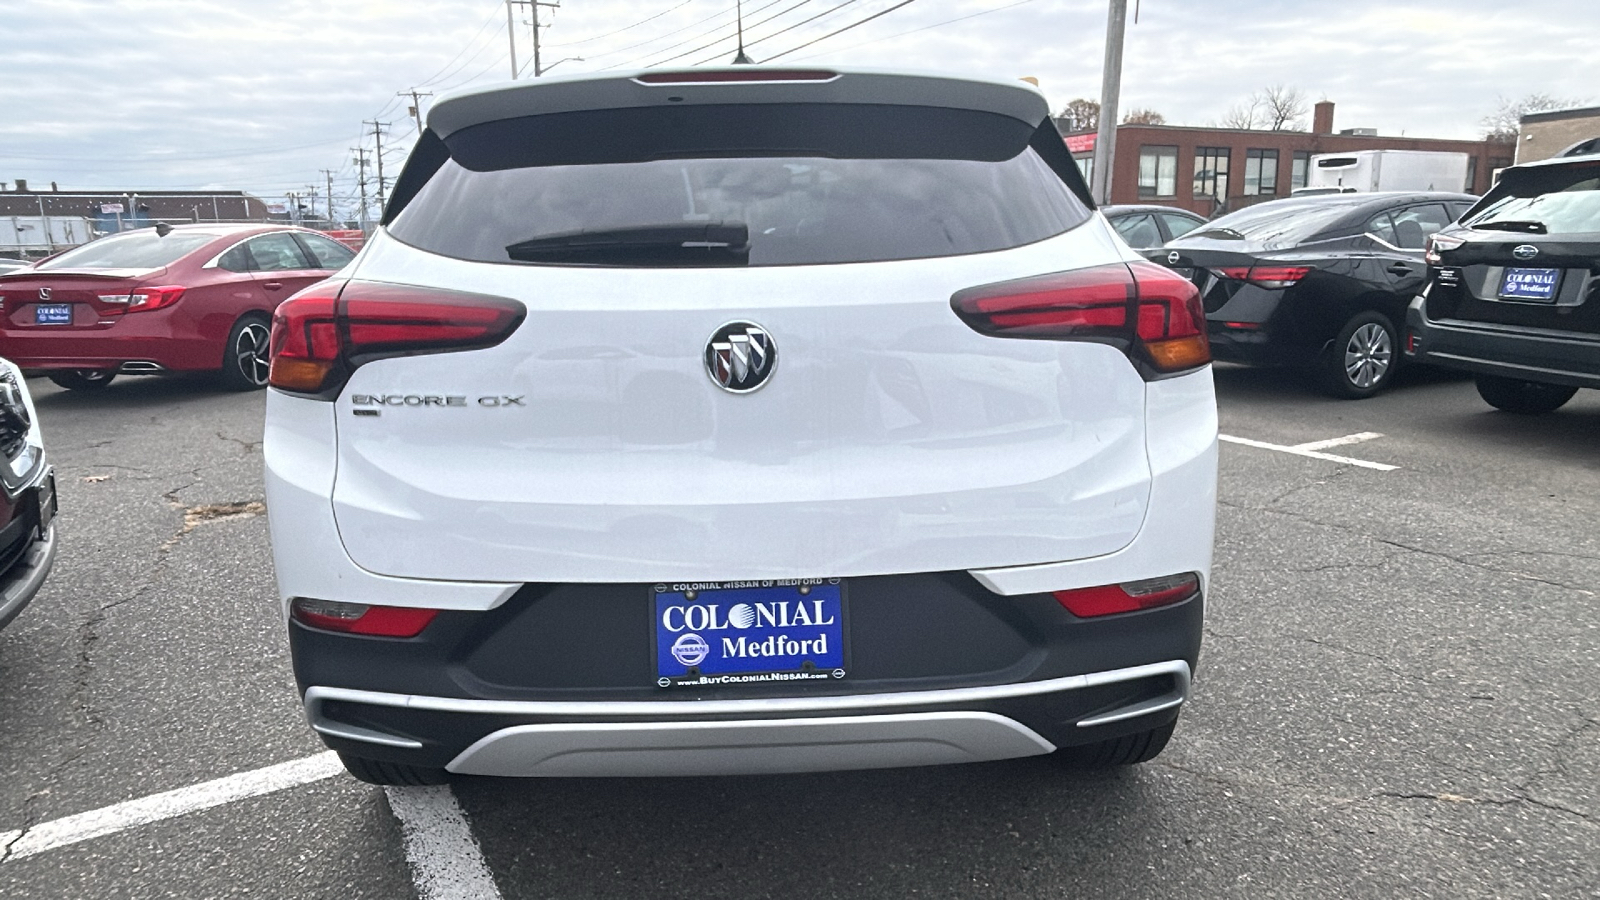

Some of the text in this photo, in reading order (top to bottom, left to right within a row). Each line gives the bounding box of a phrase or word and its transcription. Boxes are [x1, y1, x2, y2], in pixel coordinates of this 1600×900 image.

[1507, 274, 1554, 284] COLONIAL
[1520, 284, 1551, 292] Medford
[352, 394, 526, 407] ENCORE GX
[672, 577, 823, 591] COLONIAL NISSAN OF MEDFORD
[662, 600, 834, 632] COLONIAL
[721, 633, 828, 659] Medford
